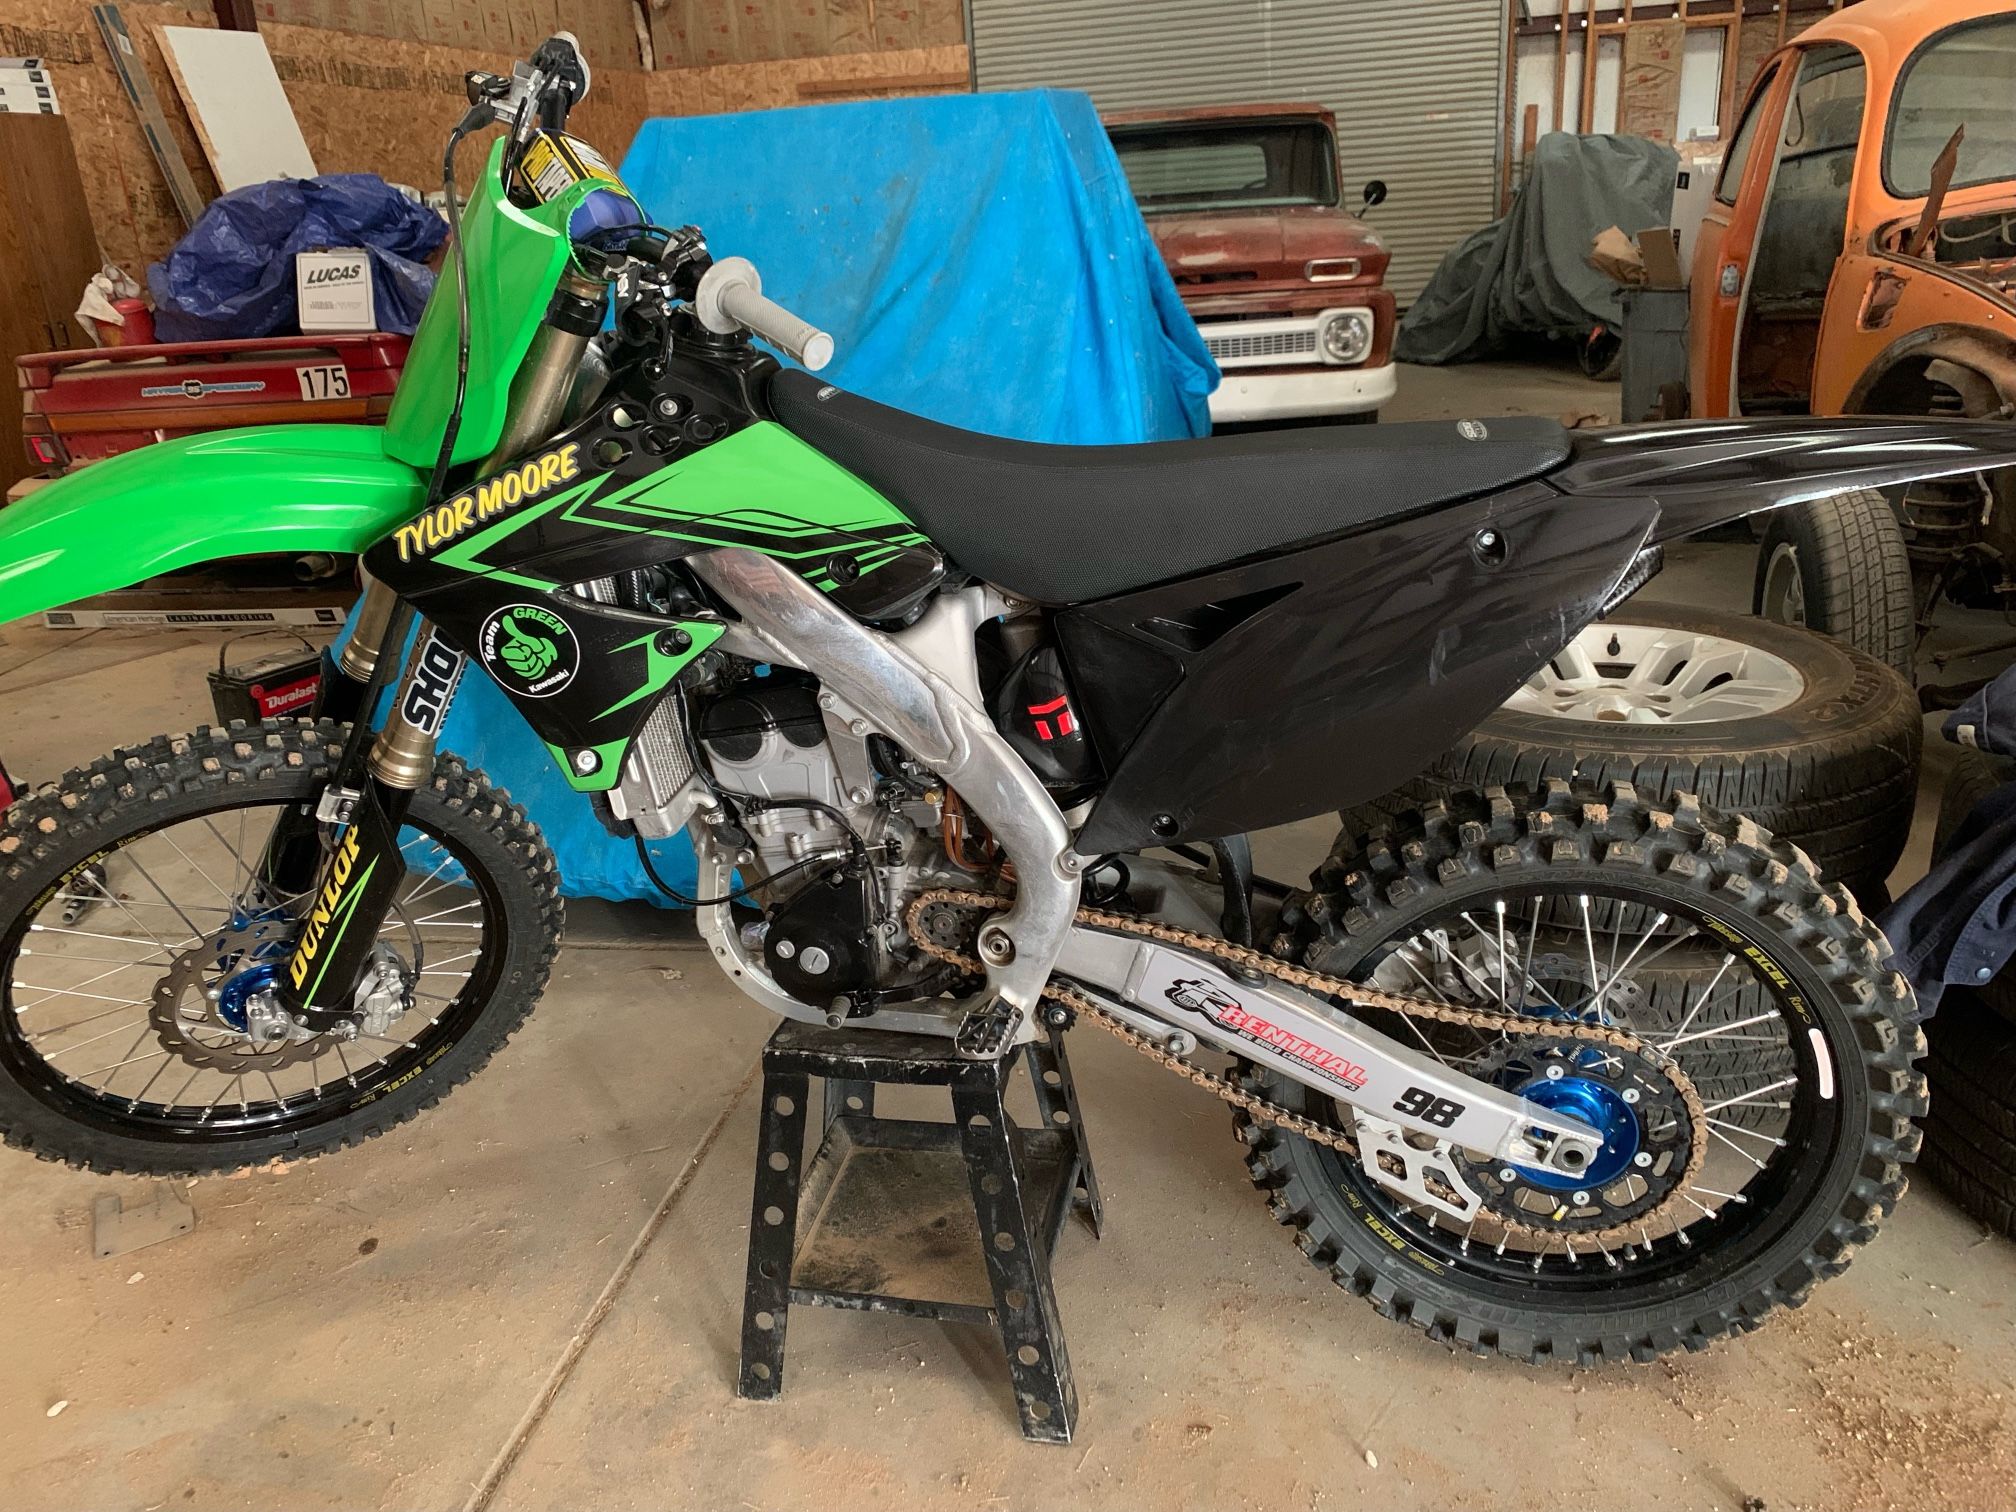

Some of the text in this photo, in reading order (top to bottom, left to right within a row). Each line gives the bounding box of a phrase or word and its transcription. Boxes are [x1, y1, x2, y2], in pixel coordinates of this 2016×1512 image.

[307, 265, 361, 284] LUCAS
[302, 368, 348, 398] 175
[394, 444, 578, 561] TYLOR MOORE
[167, 614, 217, 623] LAMINATE
[221, 613, 273, 622] FLOORING
[484, 607, 567, 662] Team GREEN
[265, 682, 317, 709] Duralast
[528, 669, 570, 693] Kawasaki
[60, 851, 110, 883] EXCEL
[290, 824, 361, 991] DUNLOP
[1744, 946, 1789, 989] EXCEL
[1218, 1005, 1366, 1085] RENTHAL
[1238, 1029, 1360, 1092] WE BUILD CHAMPIONSHIPS
[382, 1065, 423, 1092] EXCEL
[1393, 1087, 1465, 1128] 98
[1364, 1212, 1406, 1250] EXCEL
